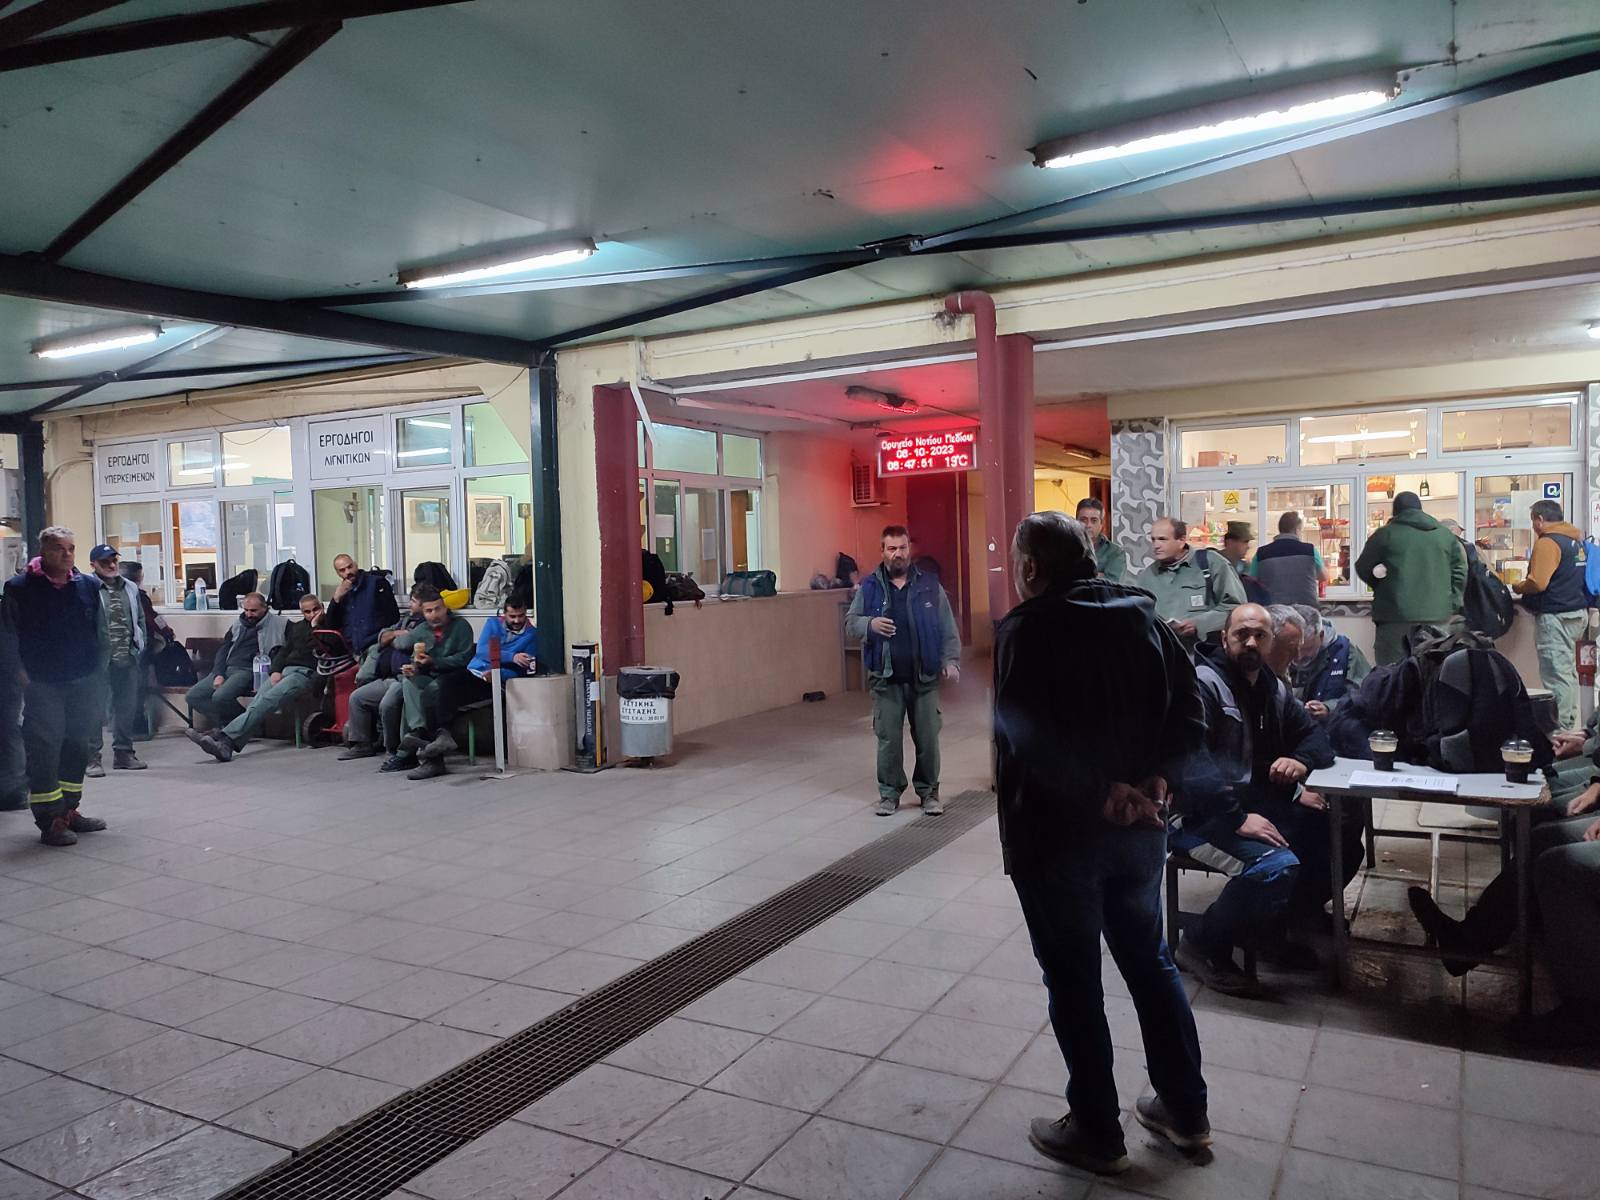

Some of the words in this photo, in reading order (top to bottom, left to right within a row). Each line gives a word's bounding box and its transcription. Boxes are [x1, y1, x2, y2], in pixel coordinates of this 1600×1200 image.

[319, 430, 374, 447] ΕΡΓΟΔΗΓΟΙ
[107, 453, 150, 468] ΕΡΓΟΔΗΓΟΙ
[324, 452, 370, 467] ΛΙΓΝΙΤΙΚΩΝ
[104, 472, 155, 485] ΥΠΕΡΚΕΙΜΕΝΩΝ
